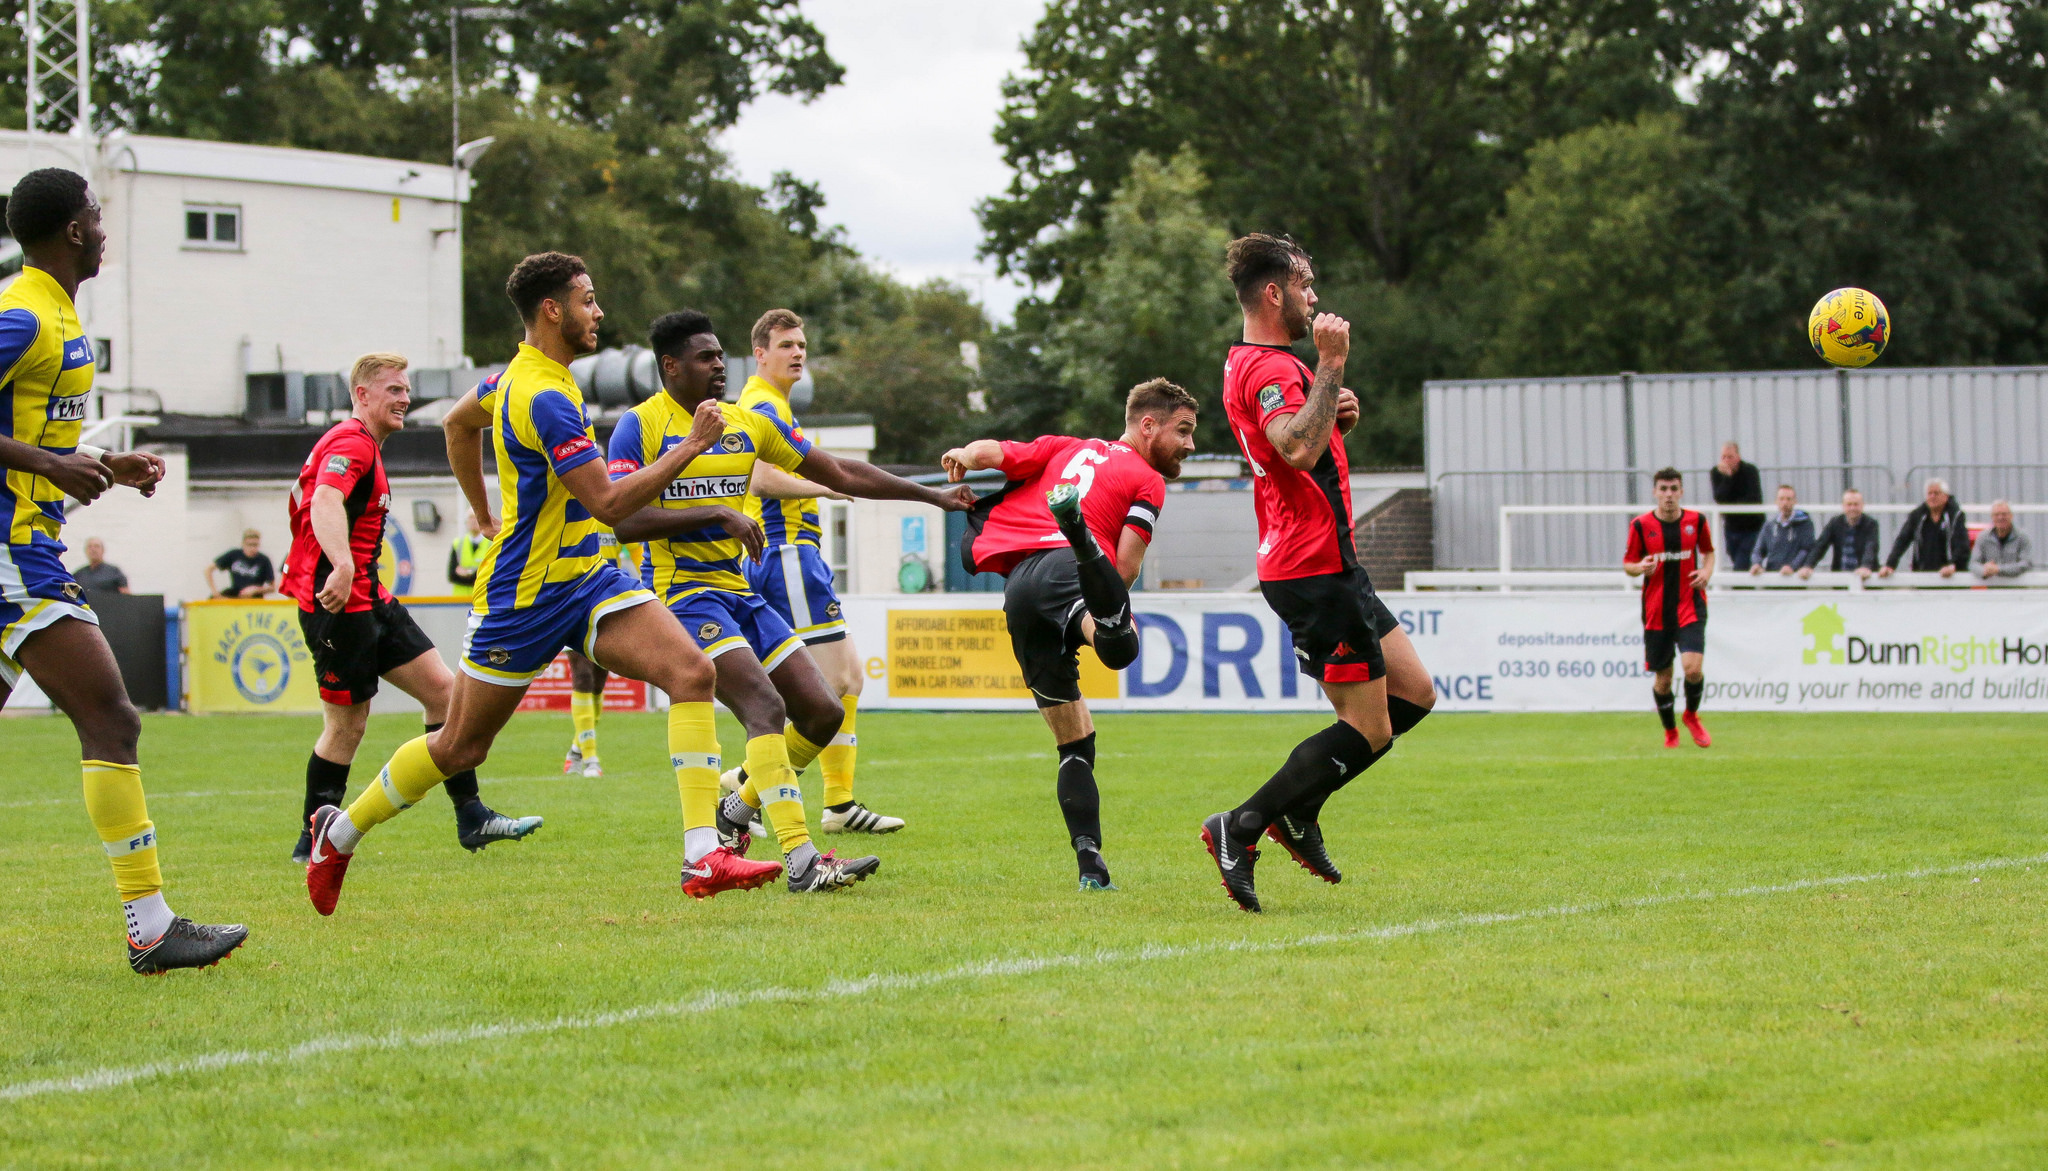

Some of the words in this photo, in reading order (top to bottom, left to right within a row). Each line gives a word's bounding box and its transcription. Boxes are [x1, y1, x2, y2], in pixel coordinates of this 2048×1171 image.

[1061, 448, 1109, 502] 5
[668, 480, 717, 497] think
[895, 617, 955, 632] AFFORDABLE
[958, 617, 996, 631] PRIVATE
[214, 621, 242, 664] BACK
[246, 612, 274, 630] THE
[895, 637, 919, 650] OPEN
[923, 637, 933, 650] TO
[936, 637, 953, 650] THE
[957, 637, 995, 650] PUBLIC!
[1498, 631, 1645, 647] depositandrent.co
[1127, 612, 1298, 698] DRI
[1848, 635, 2048, 672] DunnRightHo
[895, 656, 962, 669] PARKBEE.COM
[1499, 660, 1550, 678] 0330
[1557, 660, 1595, 678] 660
[896, 675, 917, 688] OWN
[920, 675, 926, 688] A
[928, 675, 947, 688] CAR
[950, 675, 981, 688] PARK?
[984, 675, 1007, 688] CALL
[1673, 677, 1789, 704] Iproving
[1799, 682, 1849, 704] your
[1857, 677, 1923, 699] home
[1930, 677, 1975, 699] and
[1983, 677, 2048, 699] buildi
